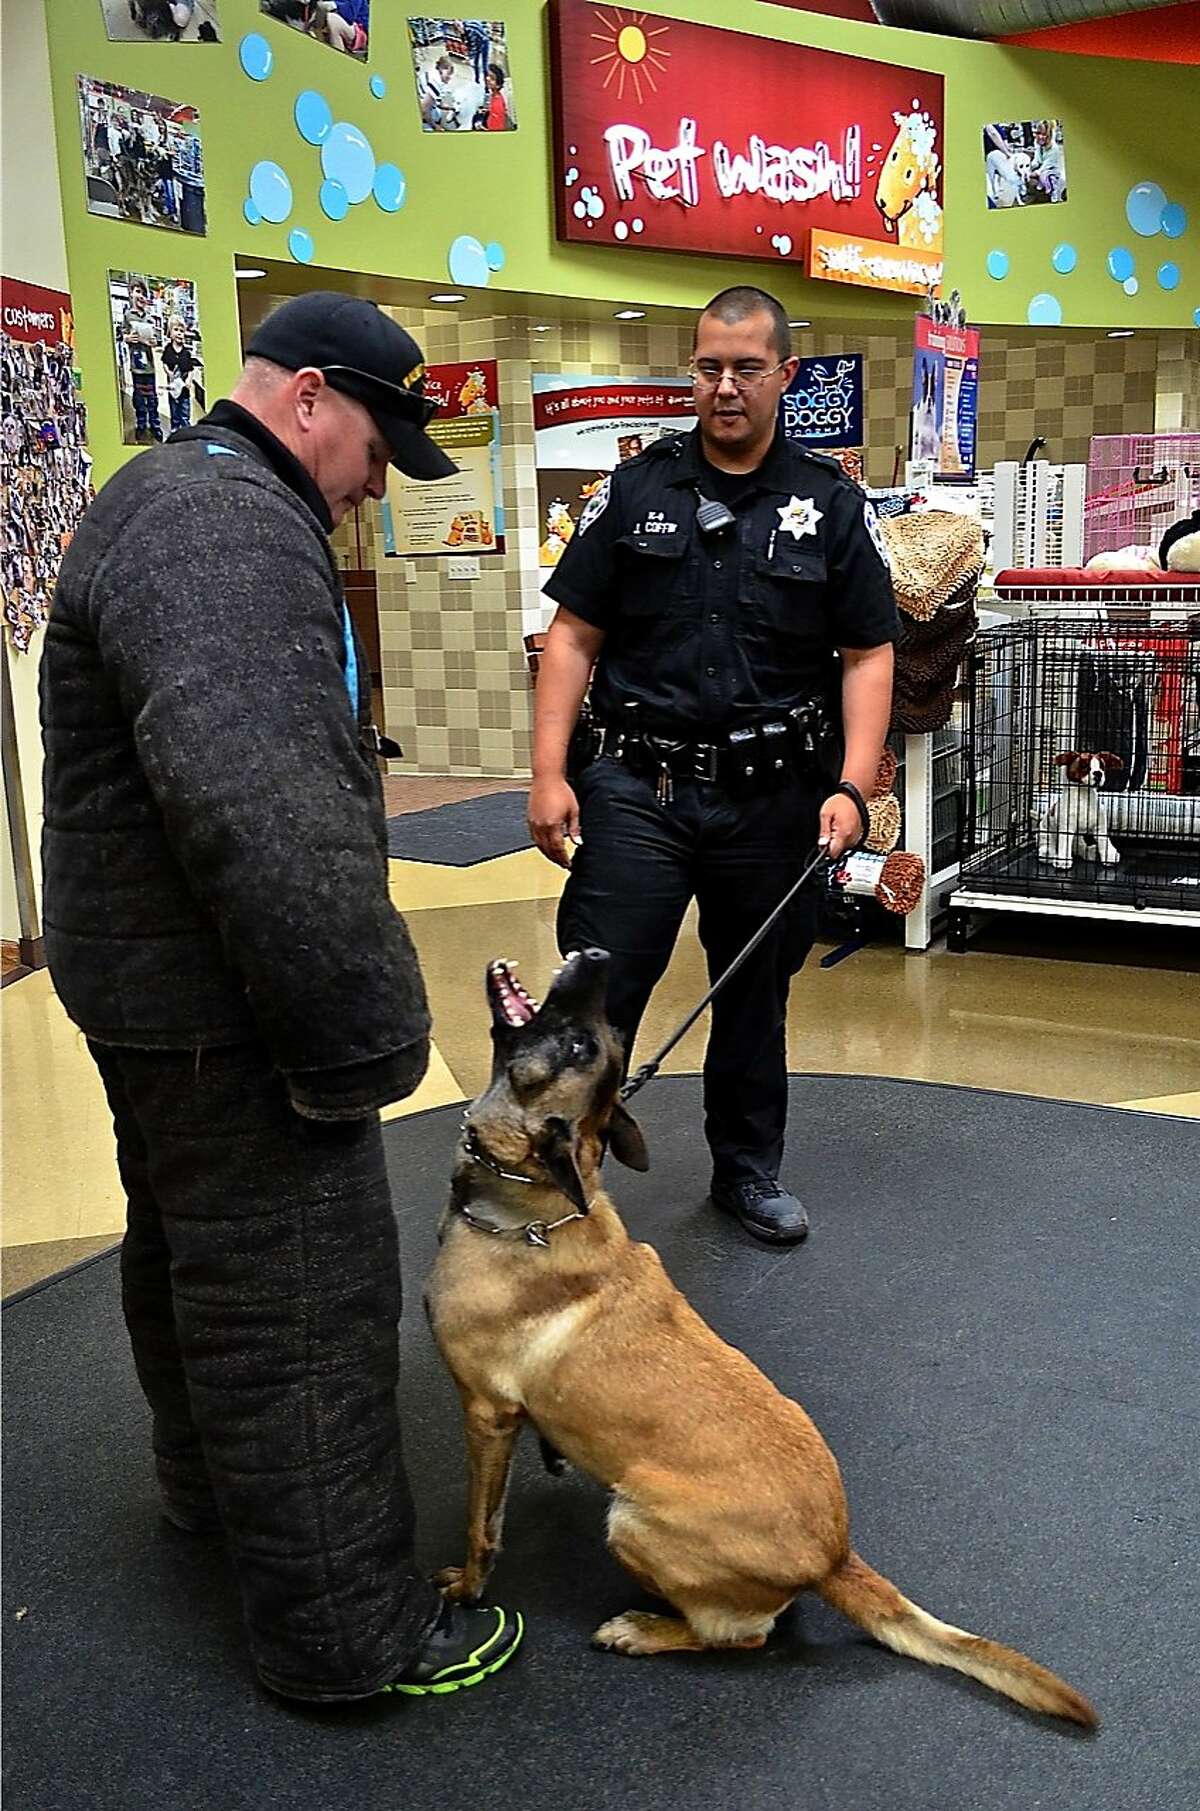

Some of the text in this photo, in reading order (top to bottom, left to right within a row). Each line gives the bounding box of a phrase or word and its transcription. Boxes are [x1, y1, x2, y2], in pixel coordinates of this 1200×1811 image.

[605, 118, 704, 207] Pet
[782, 389, 853, 411] SOGGY
[784, 406, 854, 428] DOGGY
